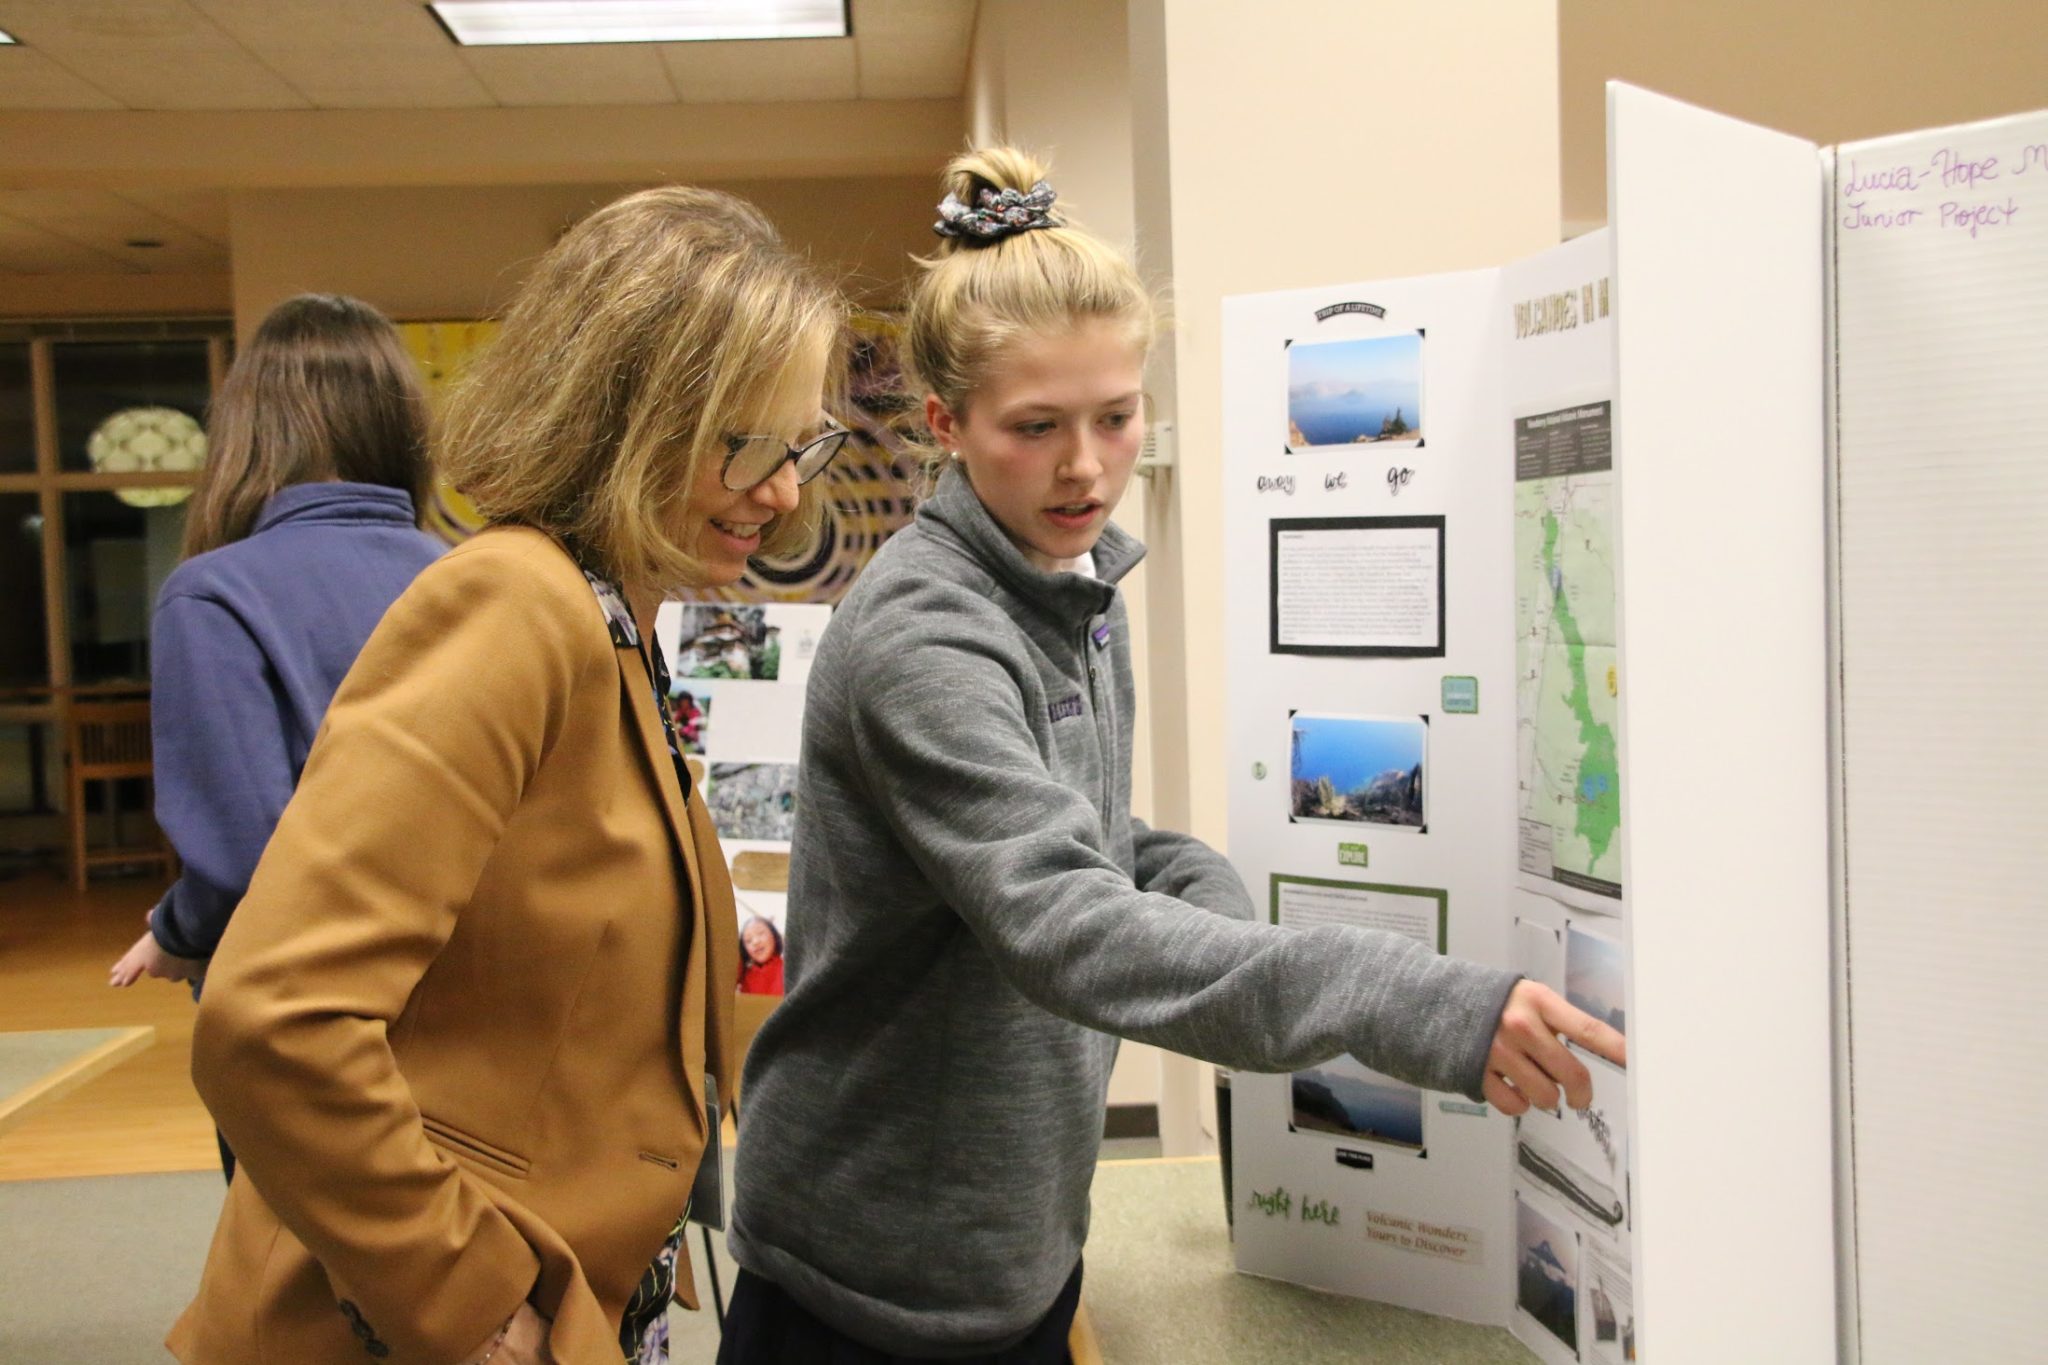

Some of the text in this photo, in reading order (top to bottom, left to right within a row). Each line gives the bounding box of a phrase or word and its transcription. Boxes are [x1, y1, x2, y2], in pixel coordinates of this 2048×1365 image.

[1844, 148, 1999, 197] Lucia-Hope
[1843, 198, 2018, 238] Junior Project
[1256, 466, 1415, 497] away we go
[1251, 1186, 1341, 1226] right here
[1366, 1210, 1469, 1242] Volcanic Wonders
[1400, 1235, 1411, 1247] to
[1415, 1236, 1467, 1258] Discover
